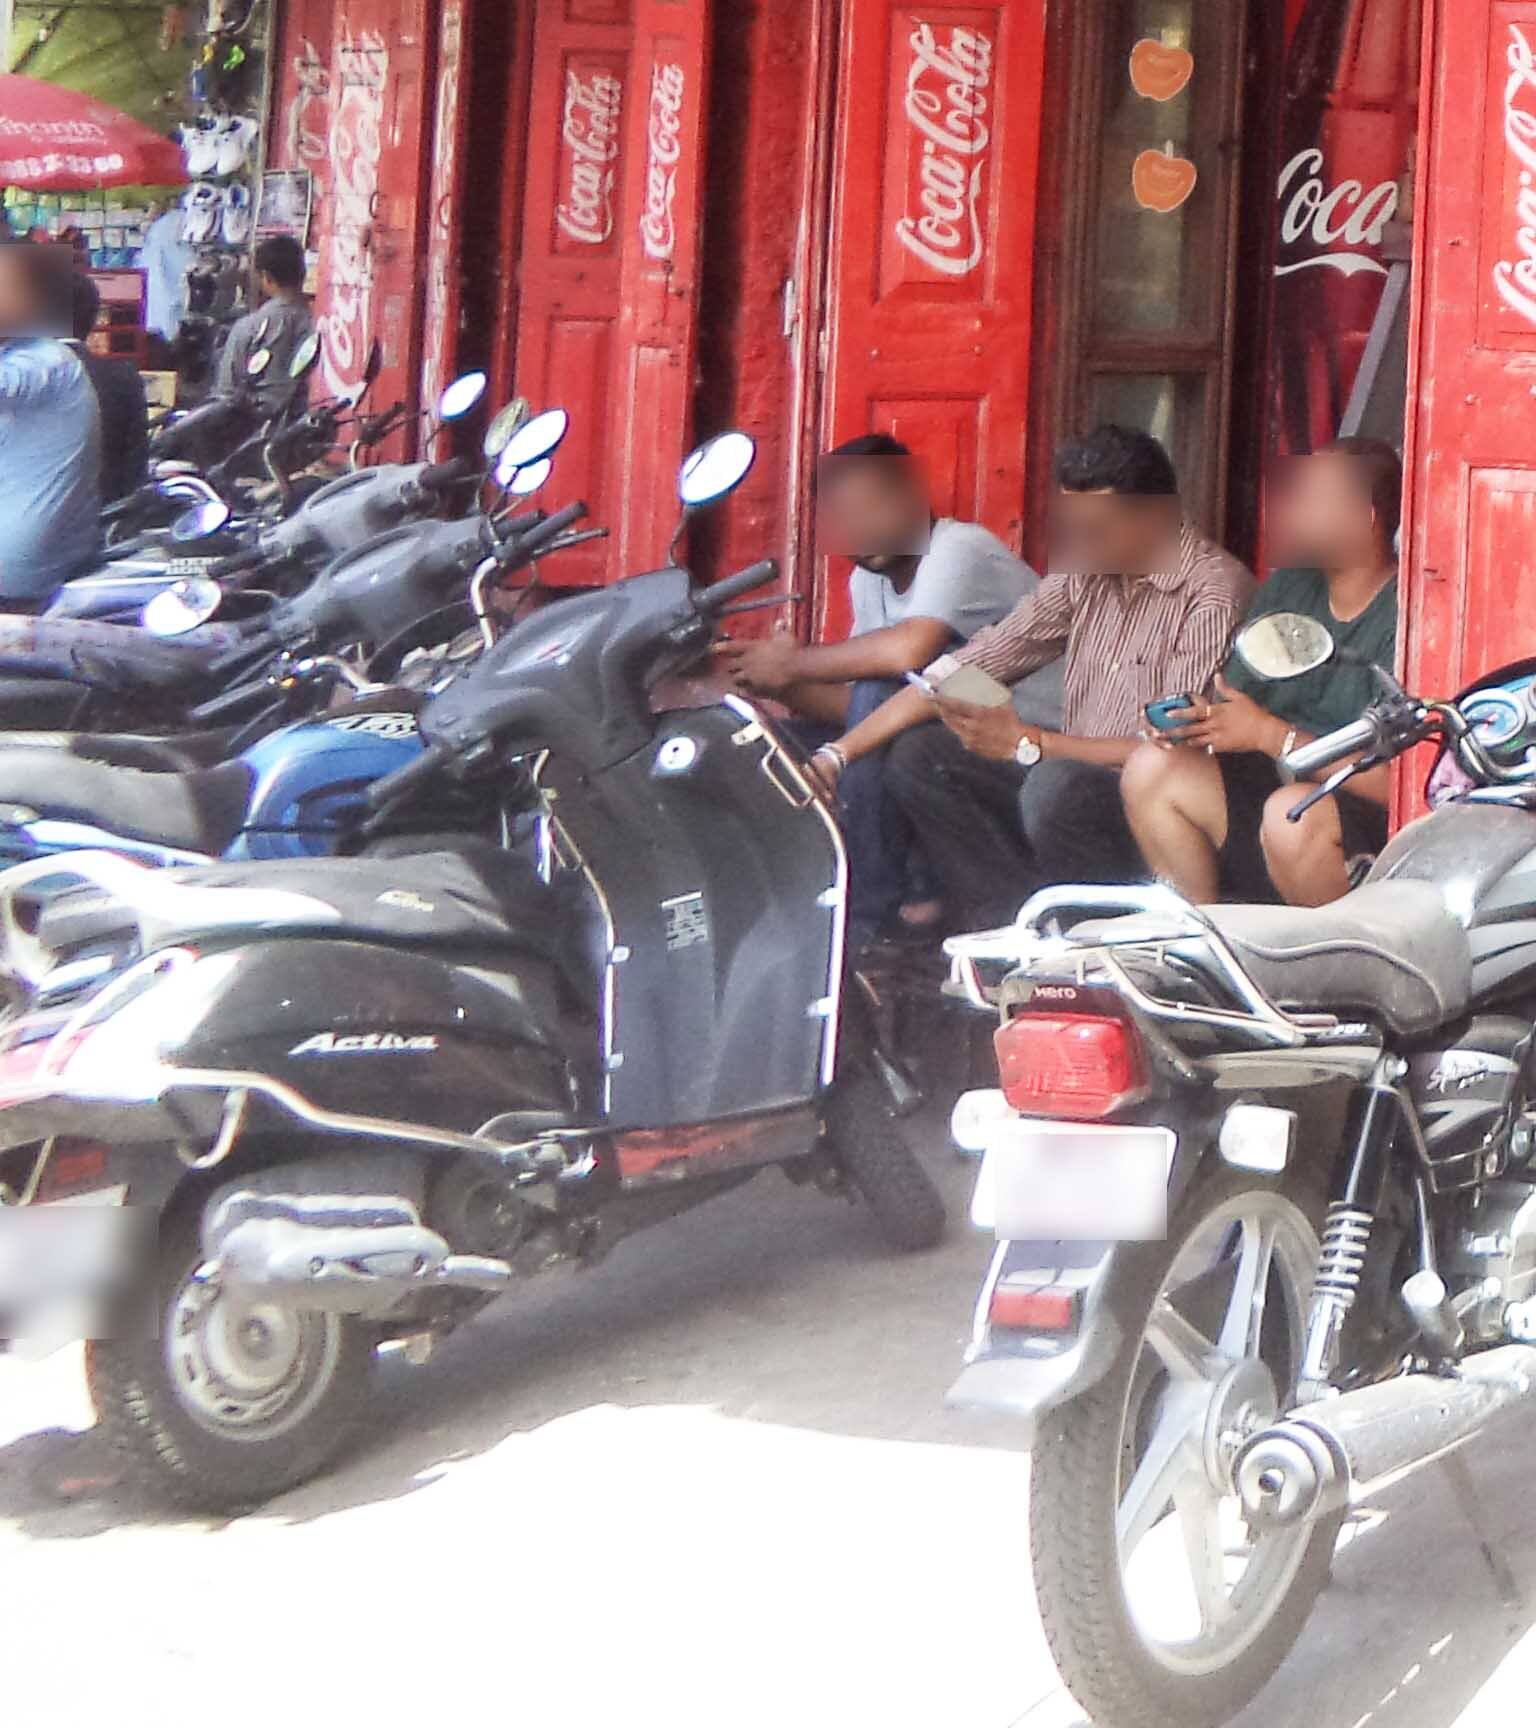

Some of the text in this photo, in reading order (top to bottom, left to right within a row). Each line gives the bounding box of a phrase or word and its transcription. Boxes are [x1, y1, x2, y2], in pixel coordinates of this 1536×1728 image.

[555, 70, 622, 244] Coca-Cola
[640, 60, 685, 259] Coca-Cola
[896, 16, 993, 276] Coca-Cola
[288, 1032, 440, 1055] Activa
